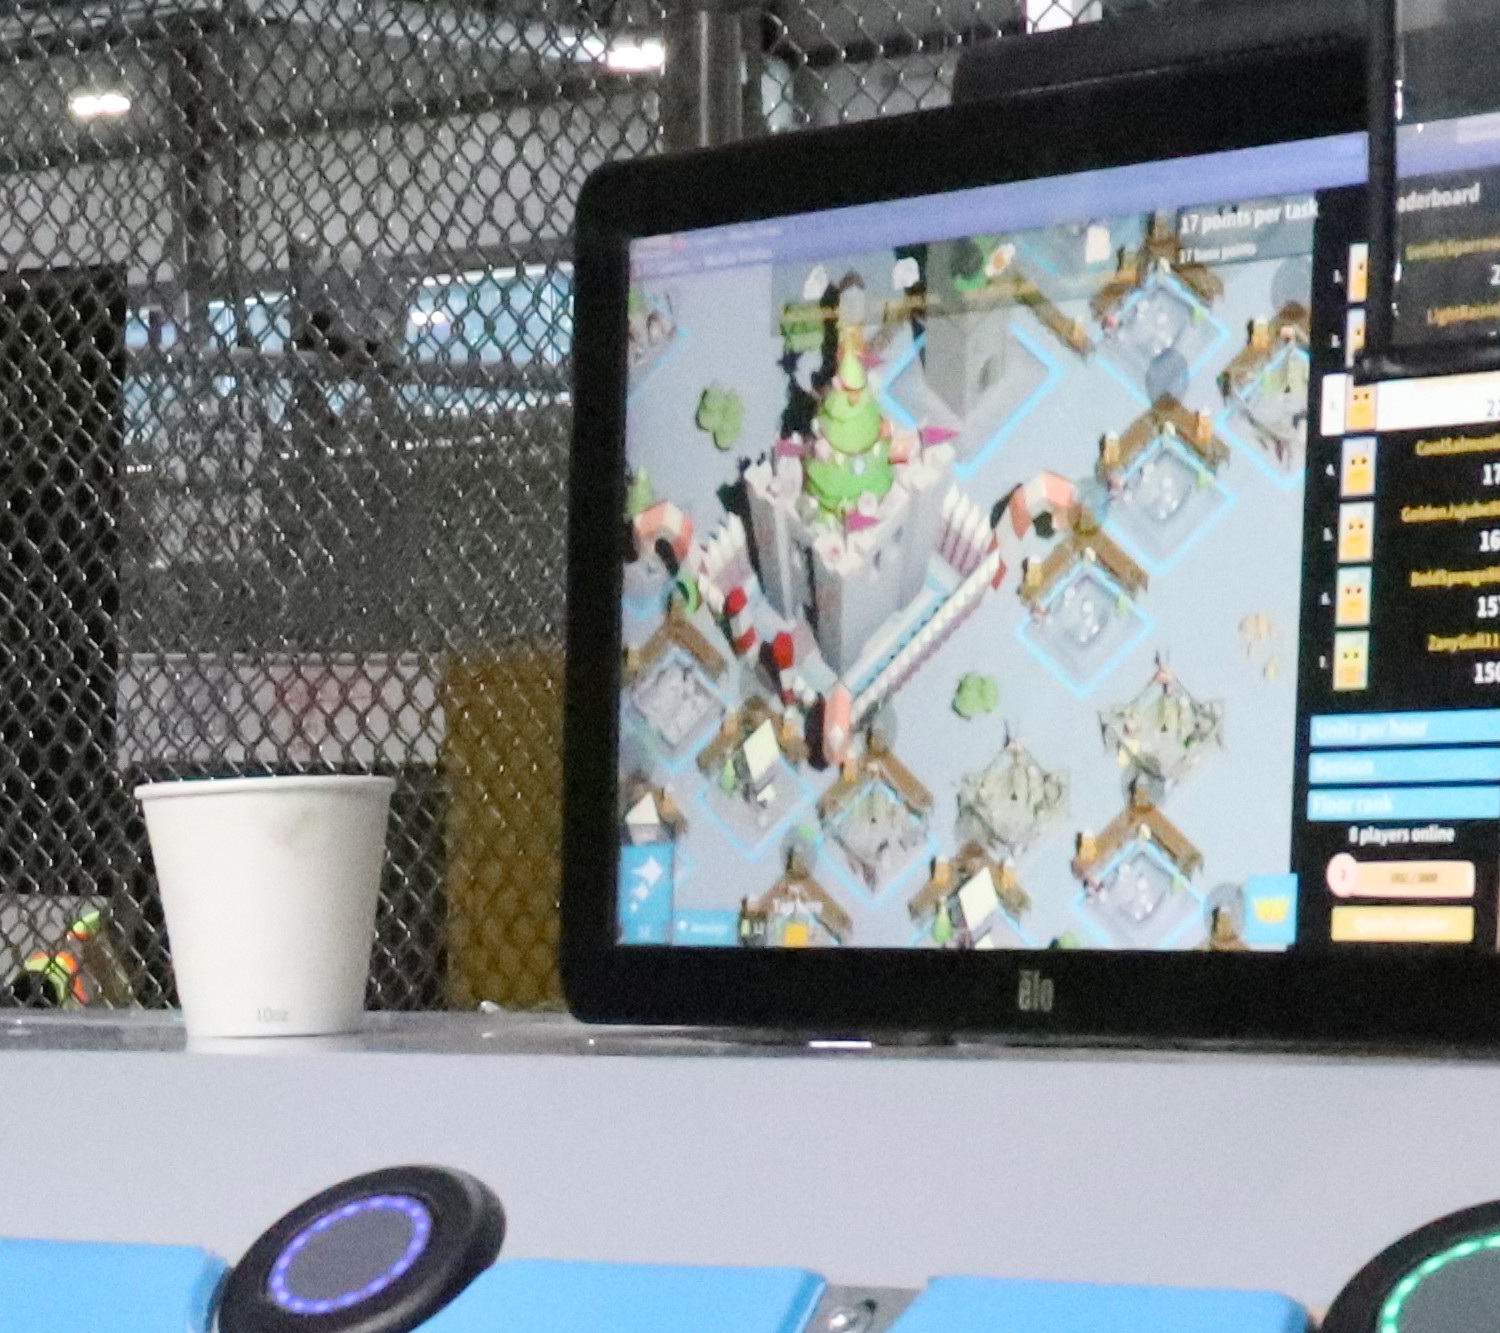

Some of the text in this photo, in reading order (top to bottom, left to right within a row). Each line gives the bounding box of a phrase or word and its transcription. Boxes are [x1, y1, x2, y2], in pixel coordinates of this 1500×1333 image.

[1202, 209, 1252, 234] points
[1254, 207, 1281, 228] per
[1284, 200, 1319, 223] task
[1359, 826, 1410, 847] players
[1411, 824, 1456, 843] online
